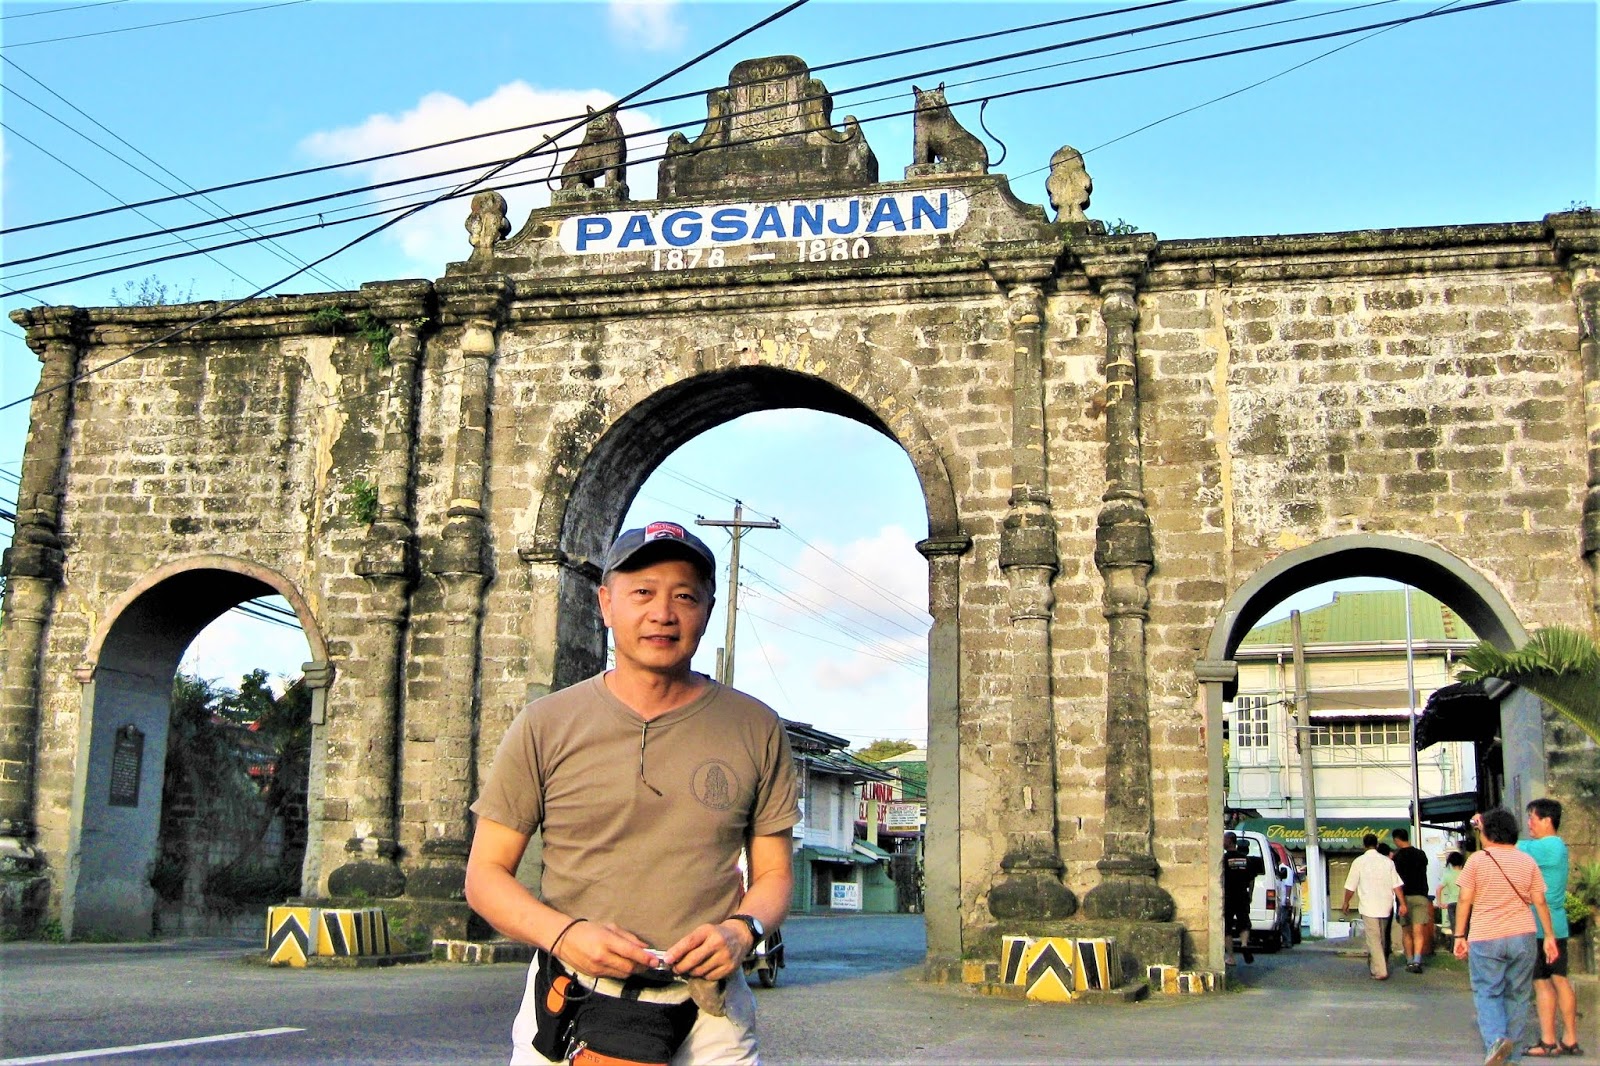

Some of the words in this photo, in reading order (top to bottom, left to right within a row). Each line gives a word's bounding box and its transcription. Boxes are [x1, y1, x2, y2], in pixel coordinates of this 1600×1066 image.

[576, 192, 949, 251] PAGSANJAN
[652, 248, 725, 271] 1878
[797, 237, 870, 263] 1880
